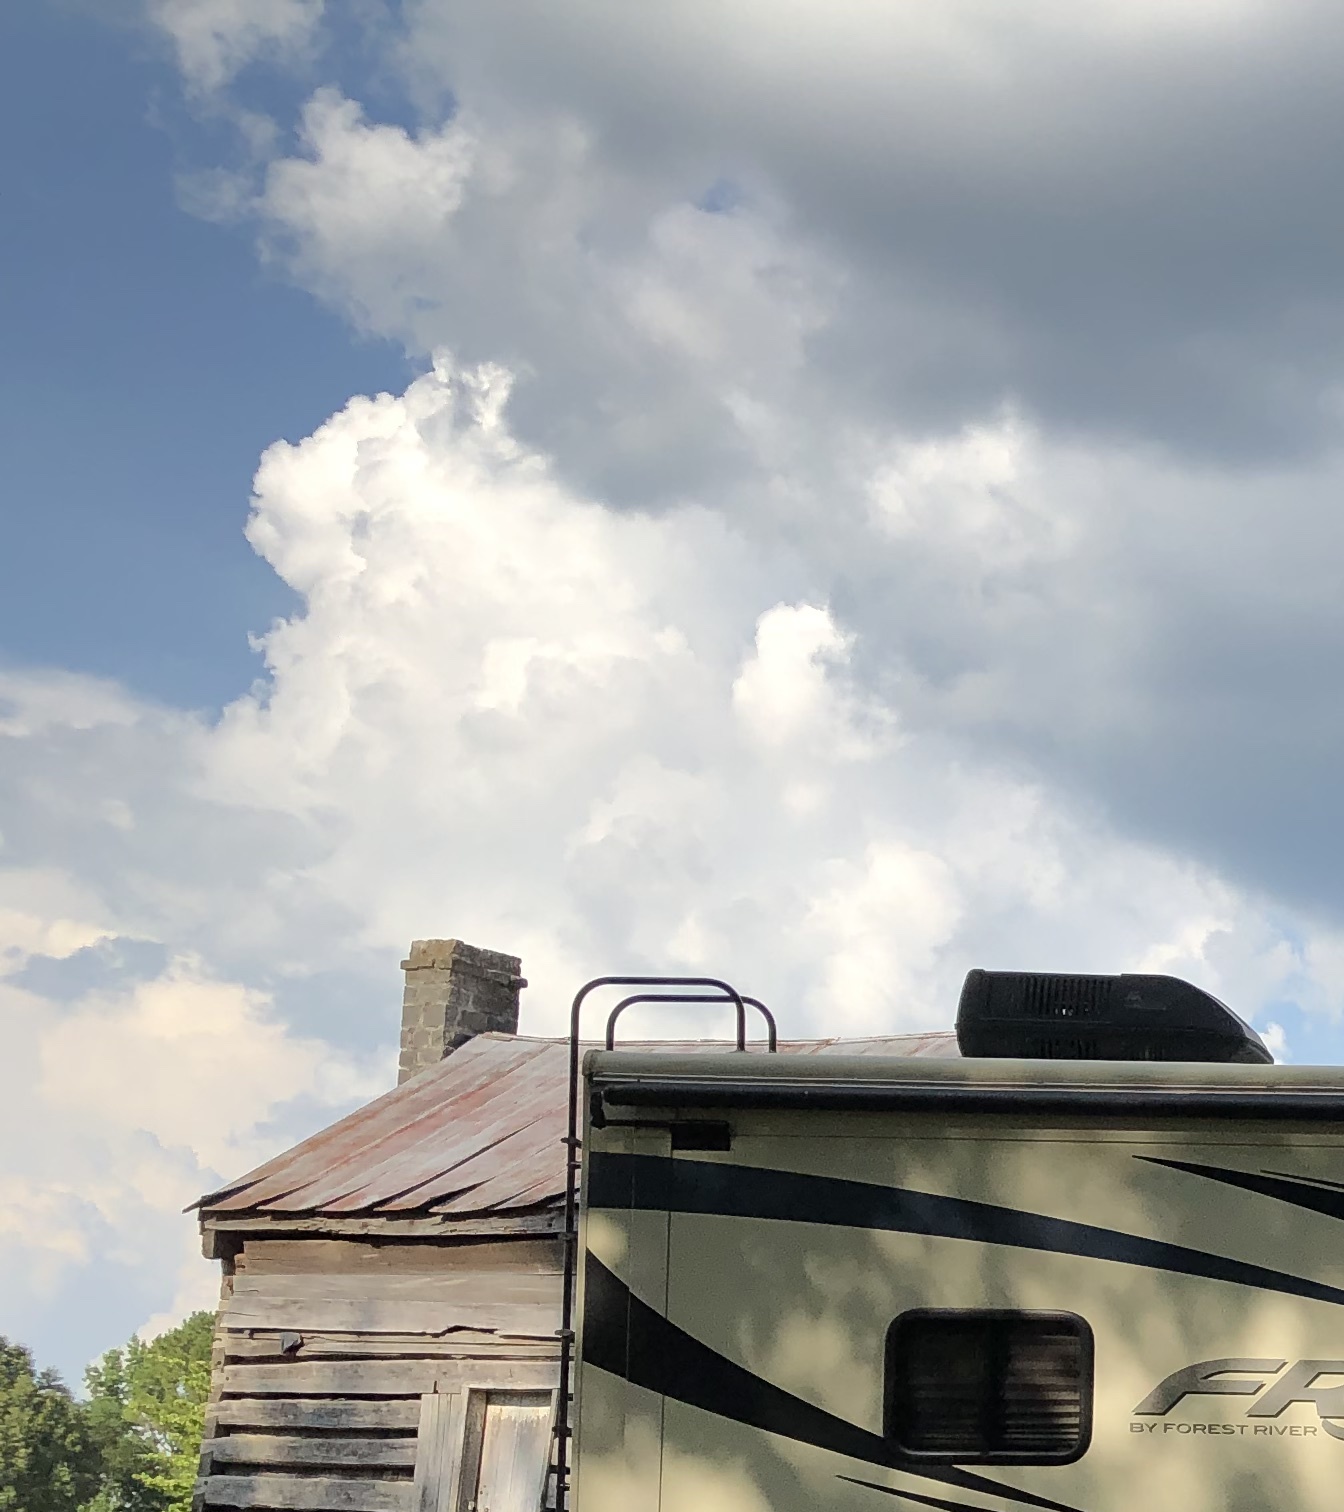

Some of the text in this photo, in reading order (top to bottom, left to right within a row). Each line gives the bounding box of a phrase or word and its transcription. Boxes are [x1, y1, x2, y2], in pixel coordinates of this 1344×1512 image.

[1129, 1421, 1318, 1437] BY FOREST RIVER
